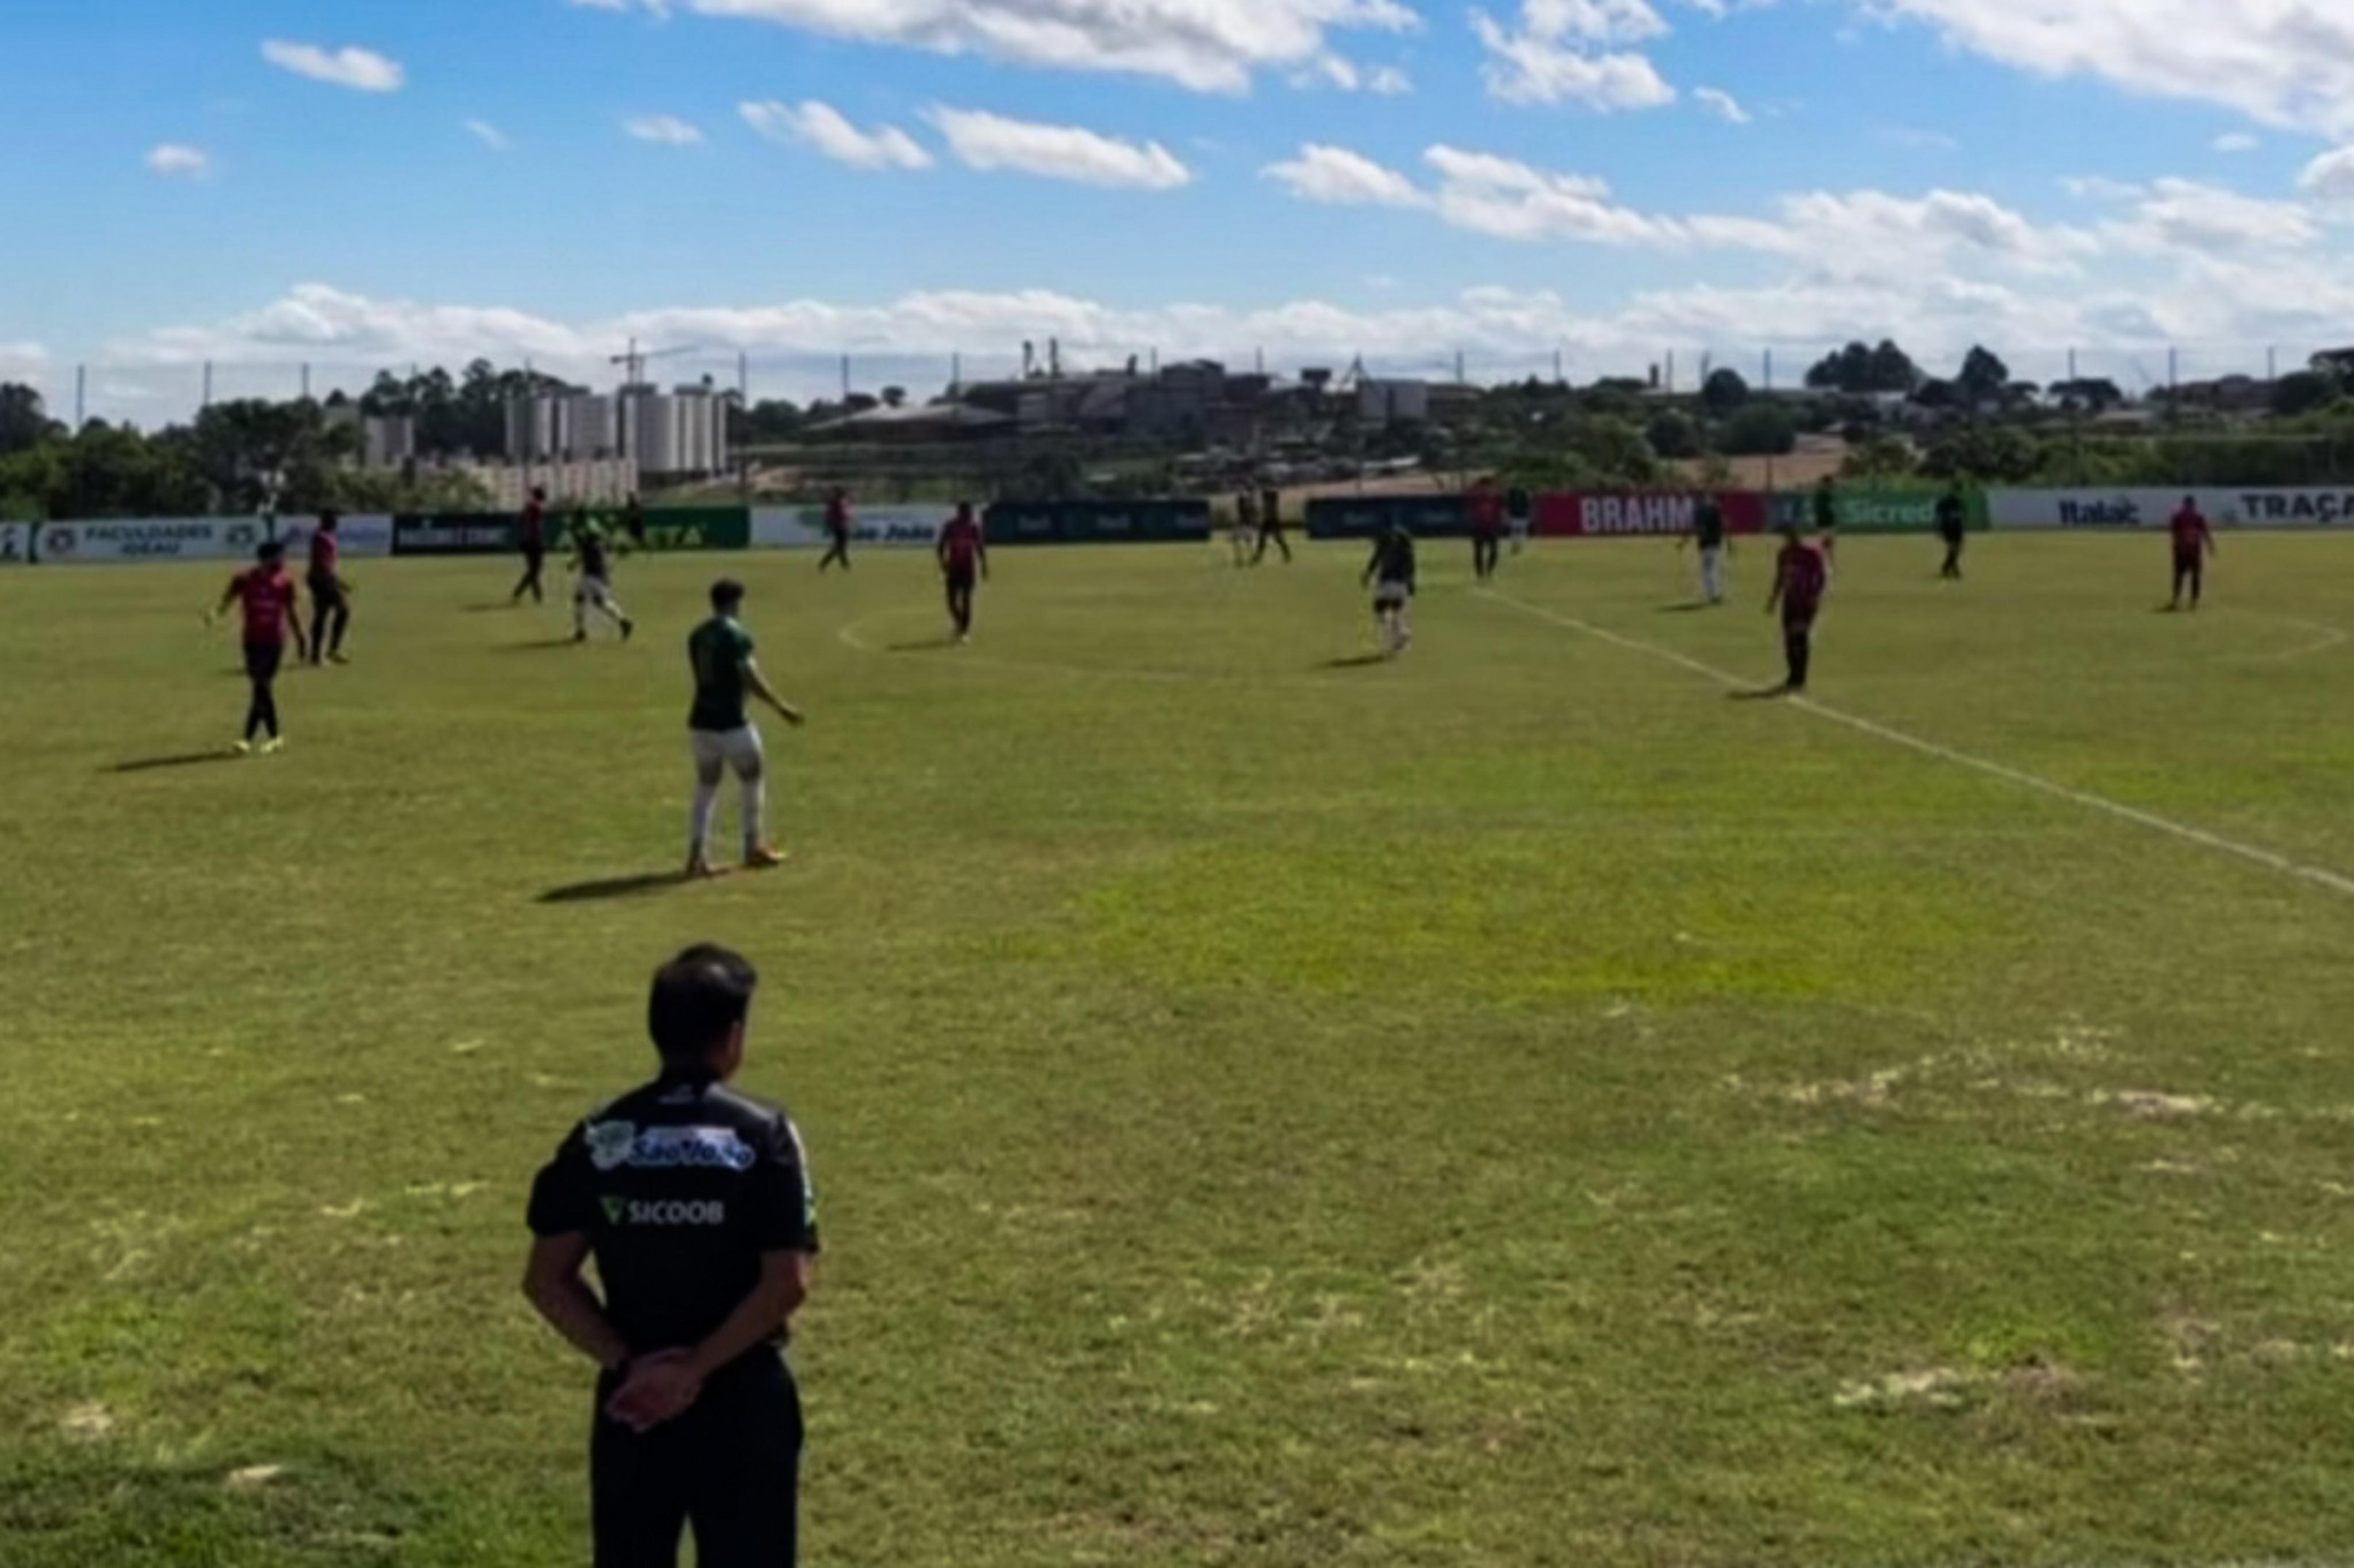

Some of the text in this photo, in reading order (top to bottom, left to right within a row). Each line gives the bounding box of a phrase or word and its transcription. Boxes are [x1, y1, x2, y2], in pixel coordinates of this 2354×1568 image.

[1580, 496, 1695, 531] BRAHM
[1843, 498, 1938, 523] Sicred
[2059, 496, 2140, 524] Italac
[85, 525, 212, 540] FACULDADES
[627, 1200, 724, 1225] SICOOB
